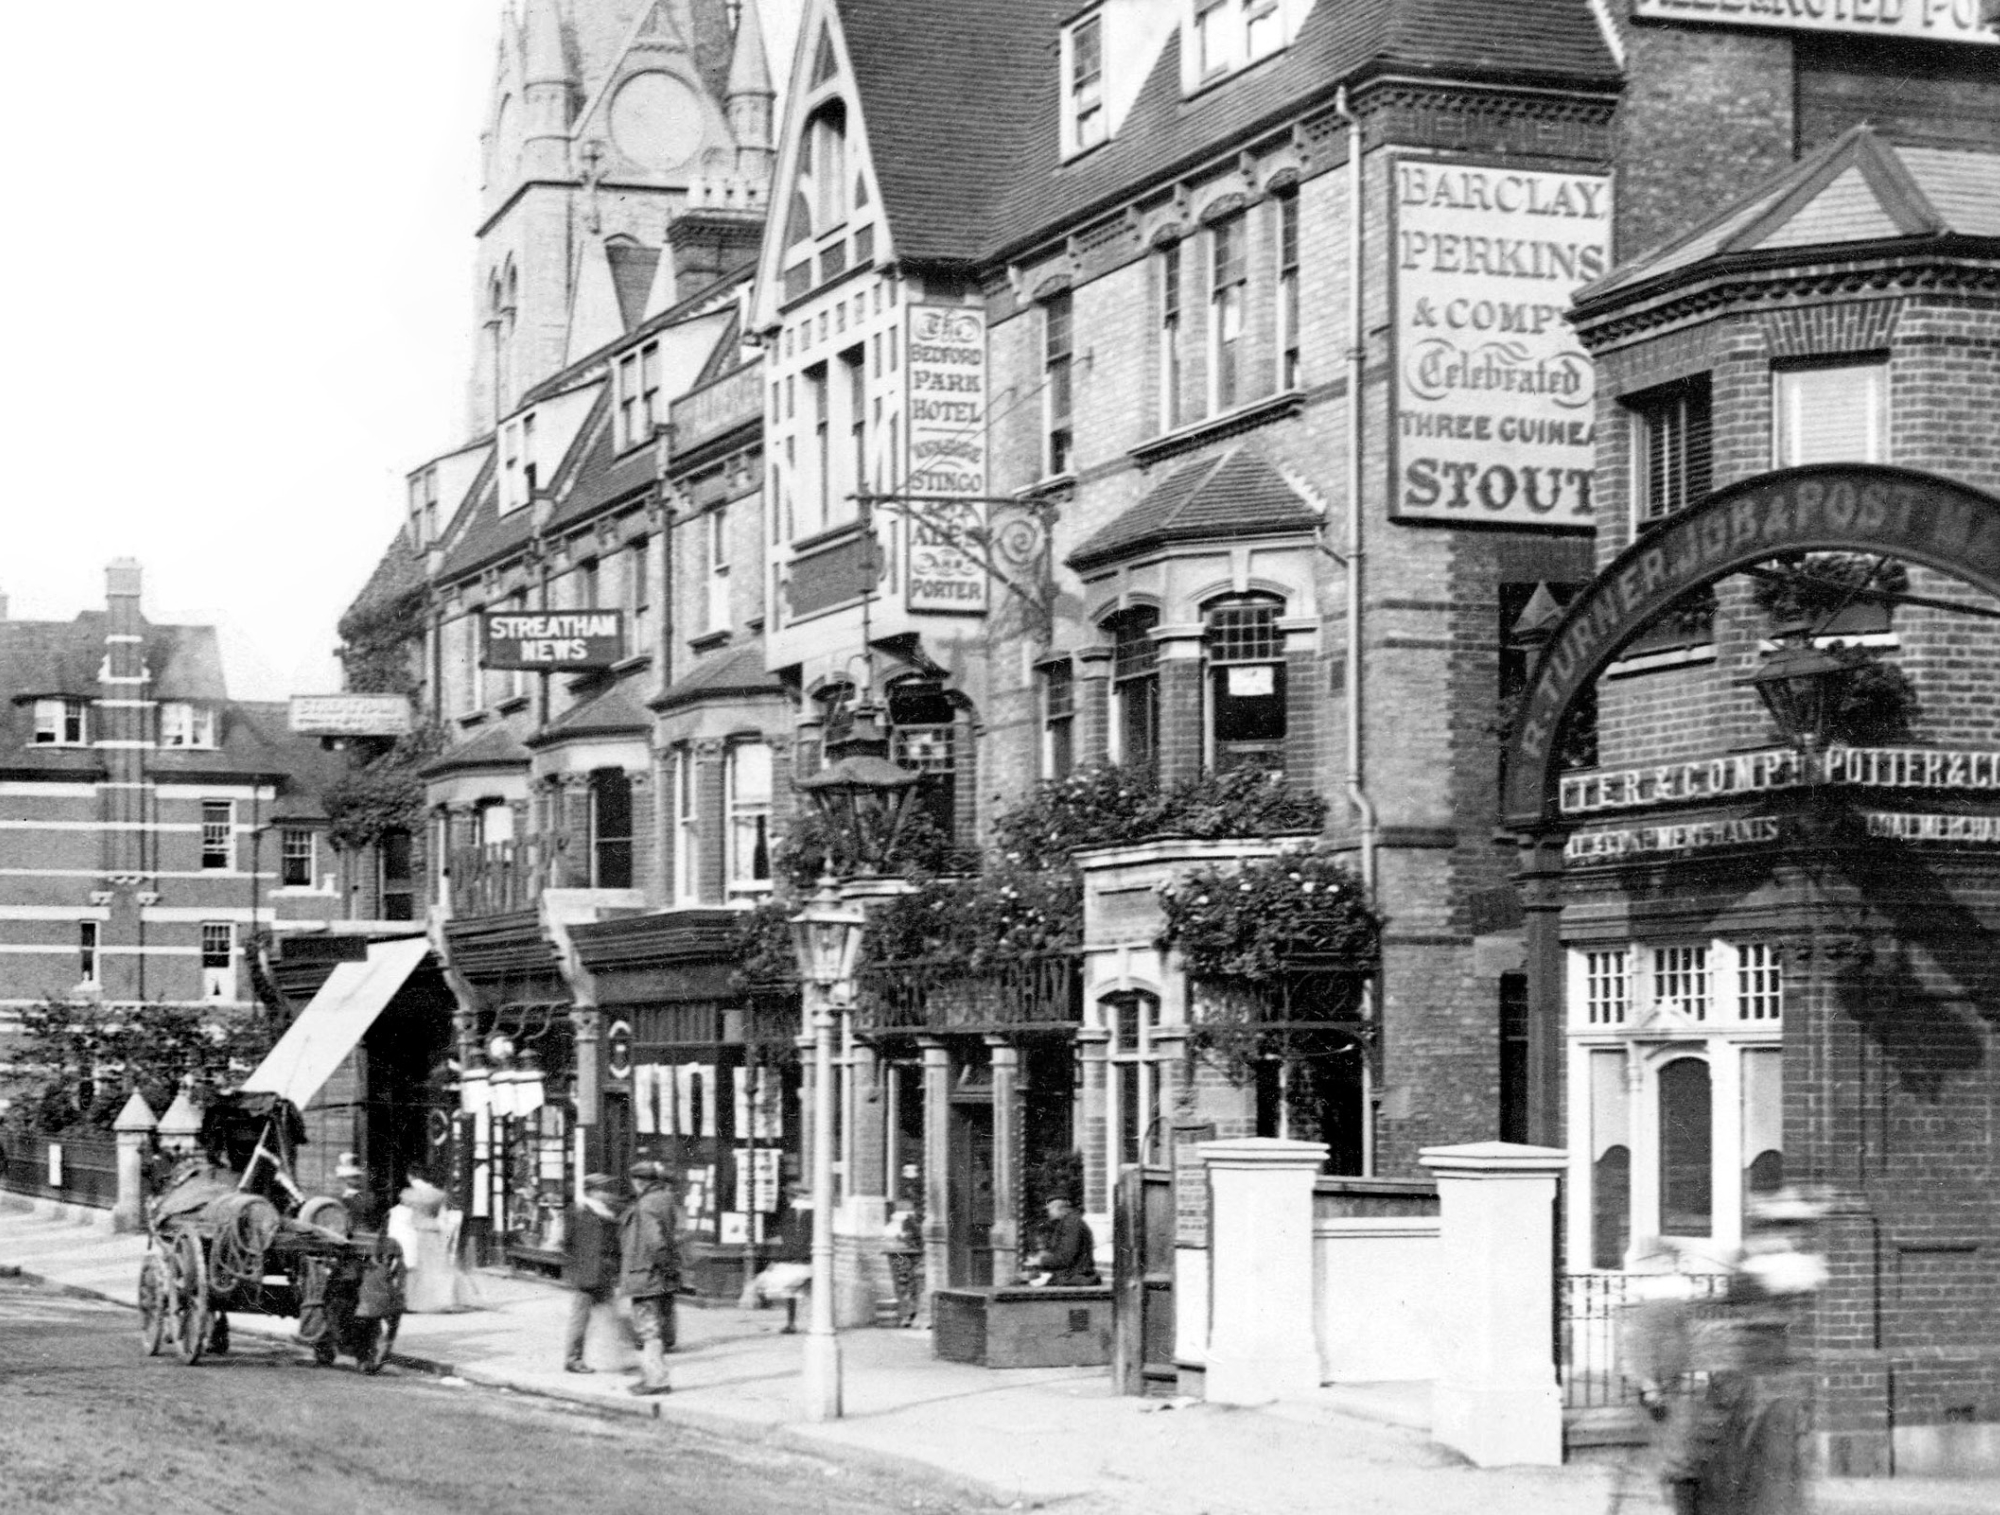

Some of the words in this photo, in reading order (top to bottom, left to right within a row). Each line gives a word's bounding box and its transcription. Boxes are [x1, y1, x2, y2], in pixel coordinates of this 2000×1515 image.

[1401, 167, 1606, 220] BARCLAY
[1401, 229, 1604, 283] PERKINS
[1412, 297, 1438, 329] &
[910, 344, 982, 367] BEDFORD
[913, 370, 982, 393] PARK
[1407, 342, 1587, 402] Celebrated
[912, 398, 982, 423] HOTEL
[1400, 409, 1492, 441] THREE
[910, 470, 982, 493] STINGO
[1404, 457, 1598, 517] STOUT
[910, 578, 982, 601] PORTER
[489, 614, 617, 640] STREATHAM
[520, 637, 588, 662] NEWS
[1825, 745, 1941, 787] POTTER
